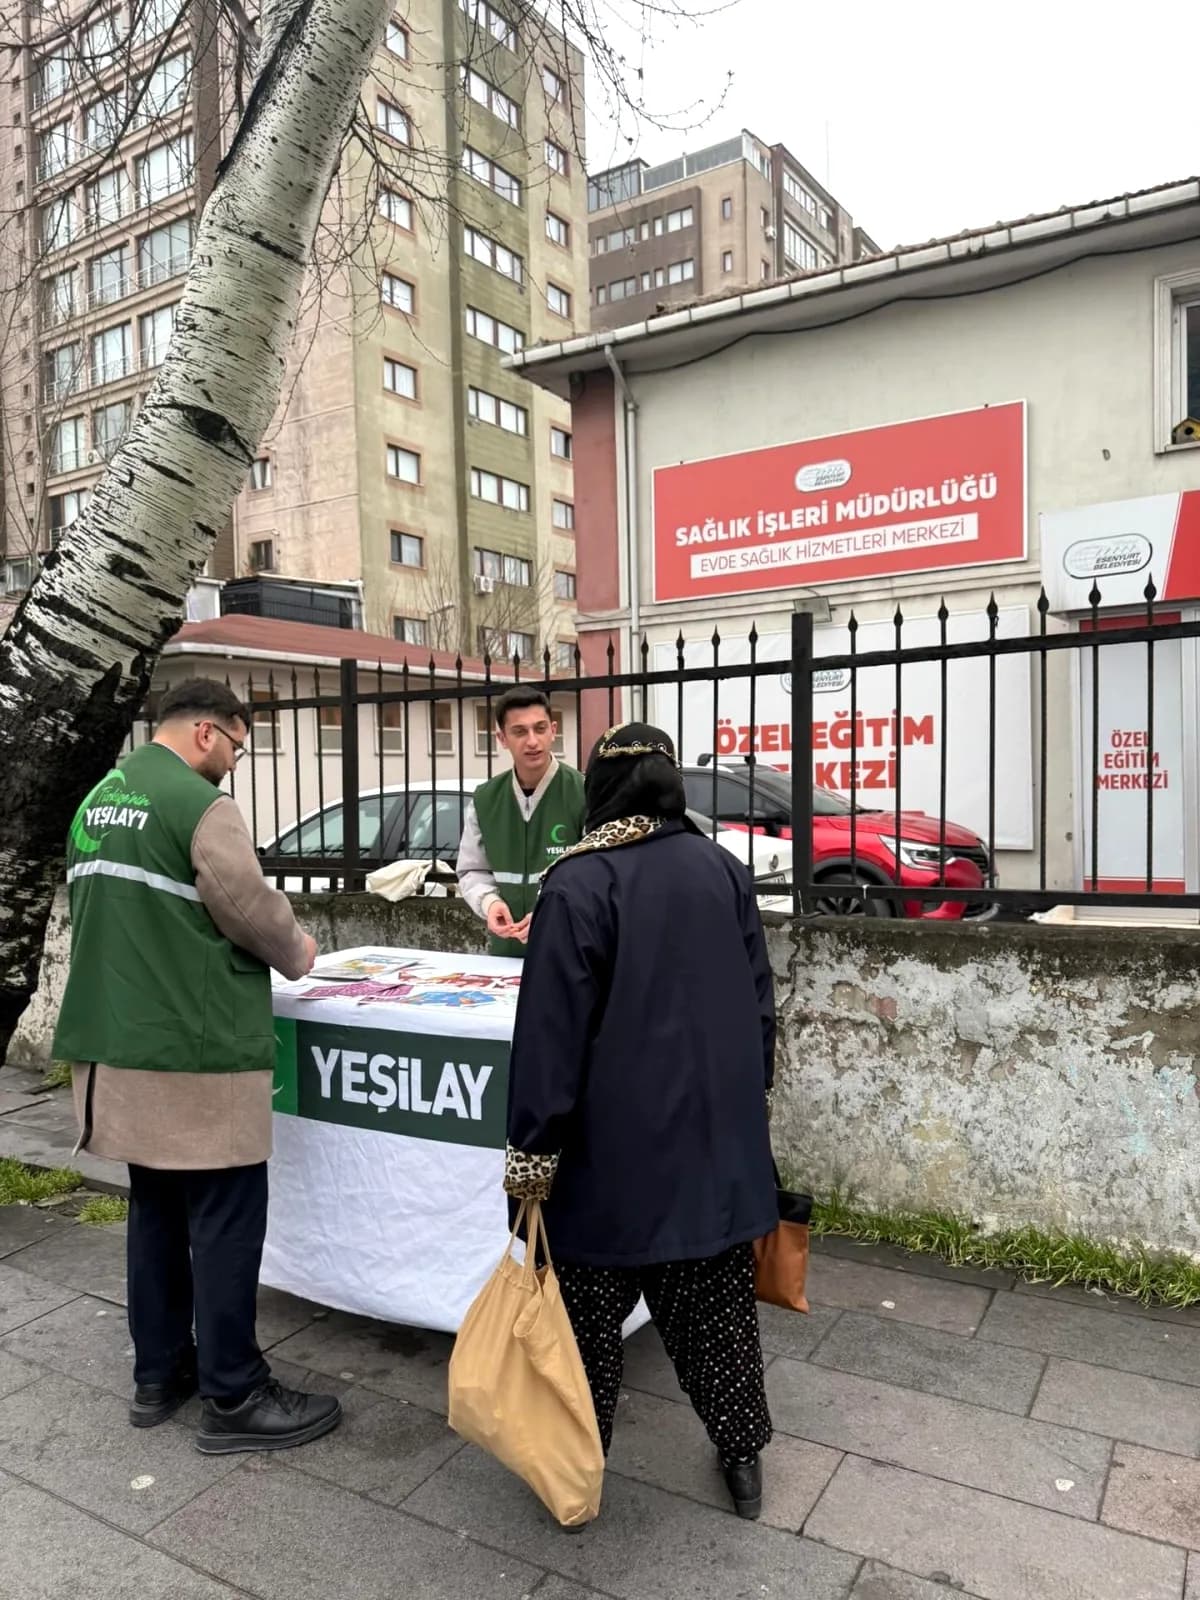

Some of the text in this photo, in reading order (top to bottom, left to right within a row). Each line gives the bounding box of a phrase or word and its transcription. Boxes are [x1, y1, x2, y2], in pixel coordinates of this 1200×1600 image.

[675, 517, 752, 546] SAĞLIK
[757, 500, 828, 538] İŞLERİ
[836, 472, 998, 522] MÜDÜRLÜĞÜ
[700, 521, 965, 573] EVDE SAĞLIK HİZMETLERİ MERKEZİ
[1095, 552, 1141, 564] ESENYURT
[812, 709, 934, 749] EĞİTİM
[771, 752, 897, 790] KEZİ
[311, 1046, 493, 1120] YEŞİLAY
